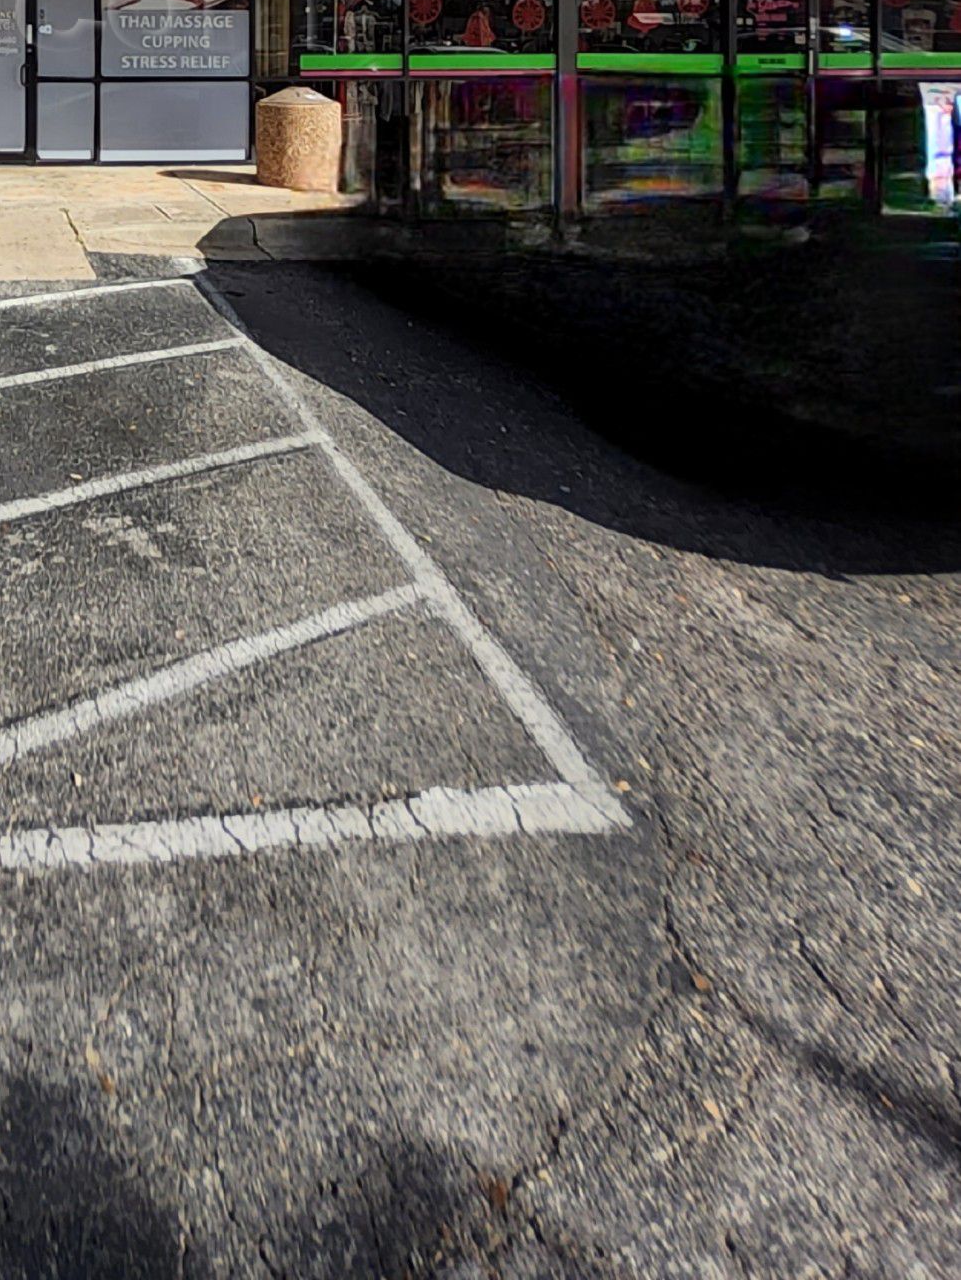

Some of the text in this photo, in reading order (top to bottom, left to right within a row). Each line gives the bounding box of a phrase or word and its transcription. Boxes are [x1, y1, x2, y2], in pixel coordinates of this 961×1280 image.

[119, 15, 234, 29] THAI MASSAGE
[142, 35, 210, 49] CUPPING
[121, 55, 230, 69] STRESS RELIEF
